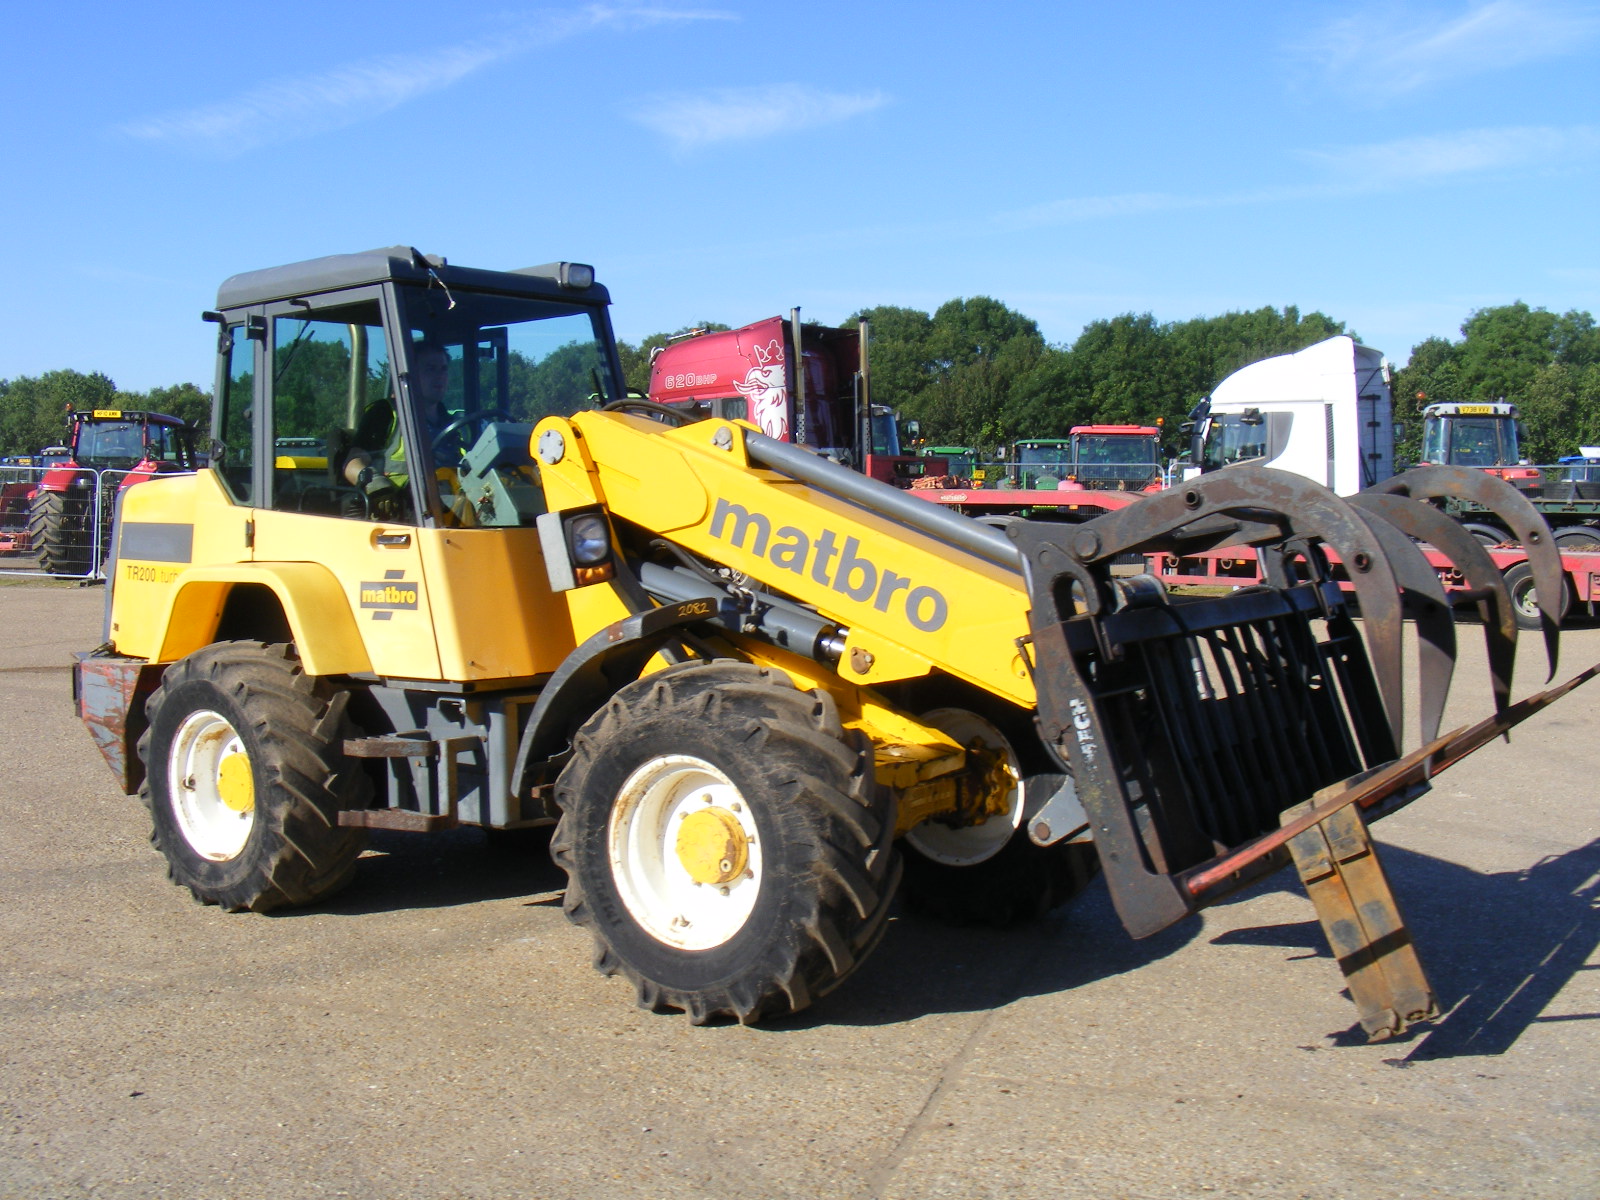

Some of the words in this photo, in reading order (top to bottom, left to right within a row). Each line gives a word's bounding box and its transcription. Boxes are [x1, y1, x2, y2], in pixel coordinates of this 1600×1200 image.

[708, 497, 948, 632] matbro
[127, 565, 156, 582] TR200
[362, 586, 416, 604] matbro
[678, 602, 710, 617] 2082
